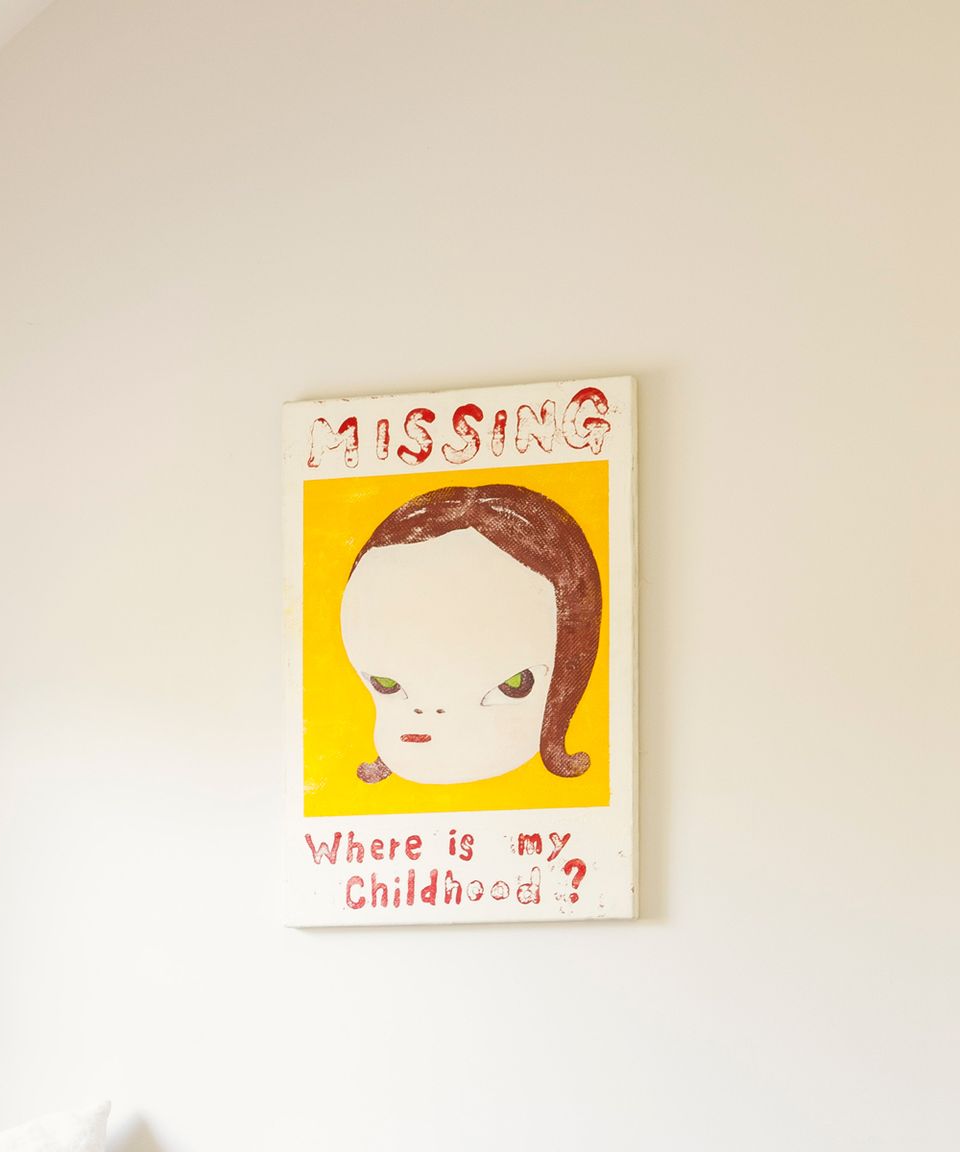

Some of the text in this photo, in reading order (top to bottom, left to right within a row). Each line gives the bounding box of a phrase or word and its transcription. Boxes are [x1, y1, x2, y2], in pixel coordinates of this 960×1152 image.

[307, 387, 611, 468] MISSING
[304, 829, 571, 865] Where is my
